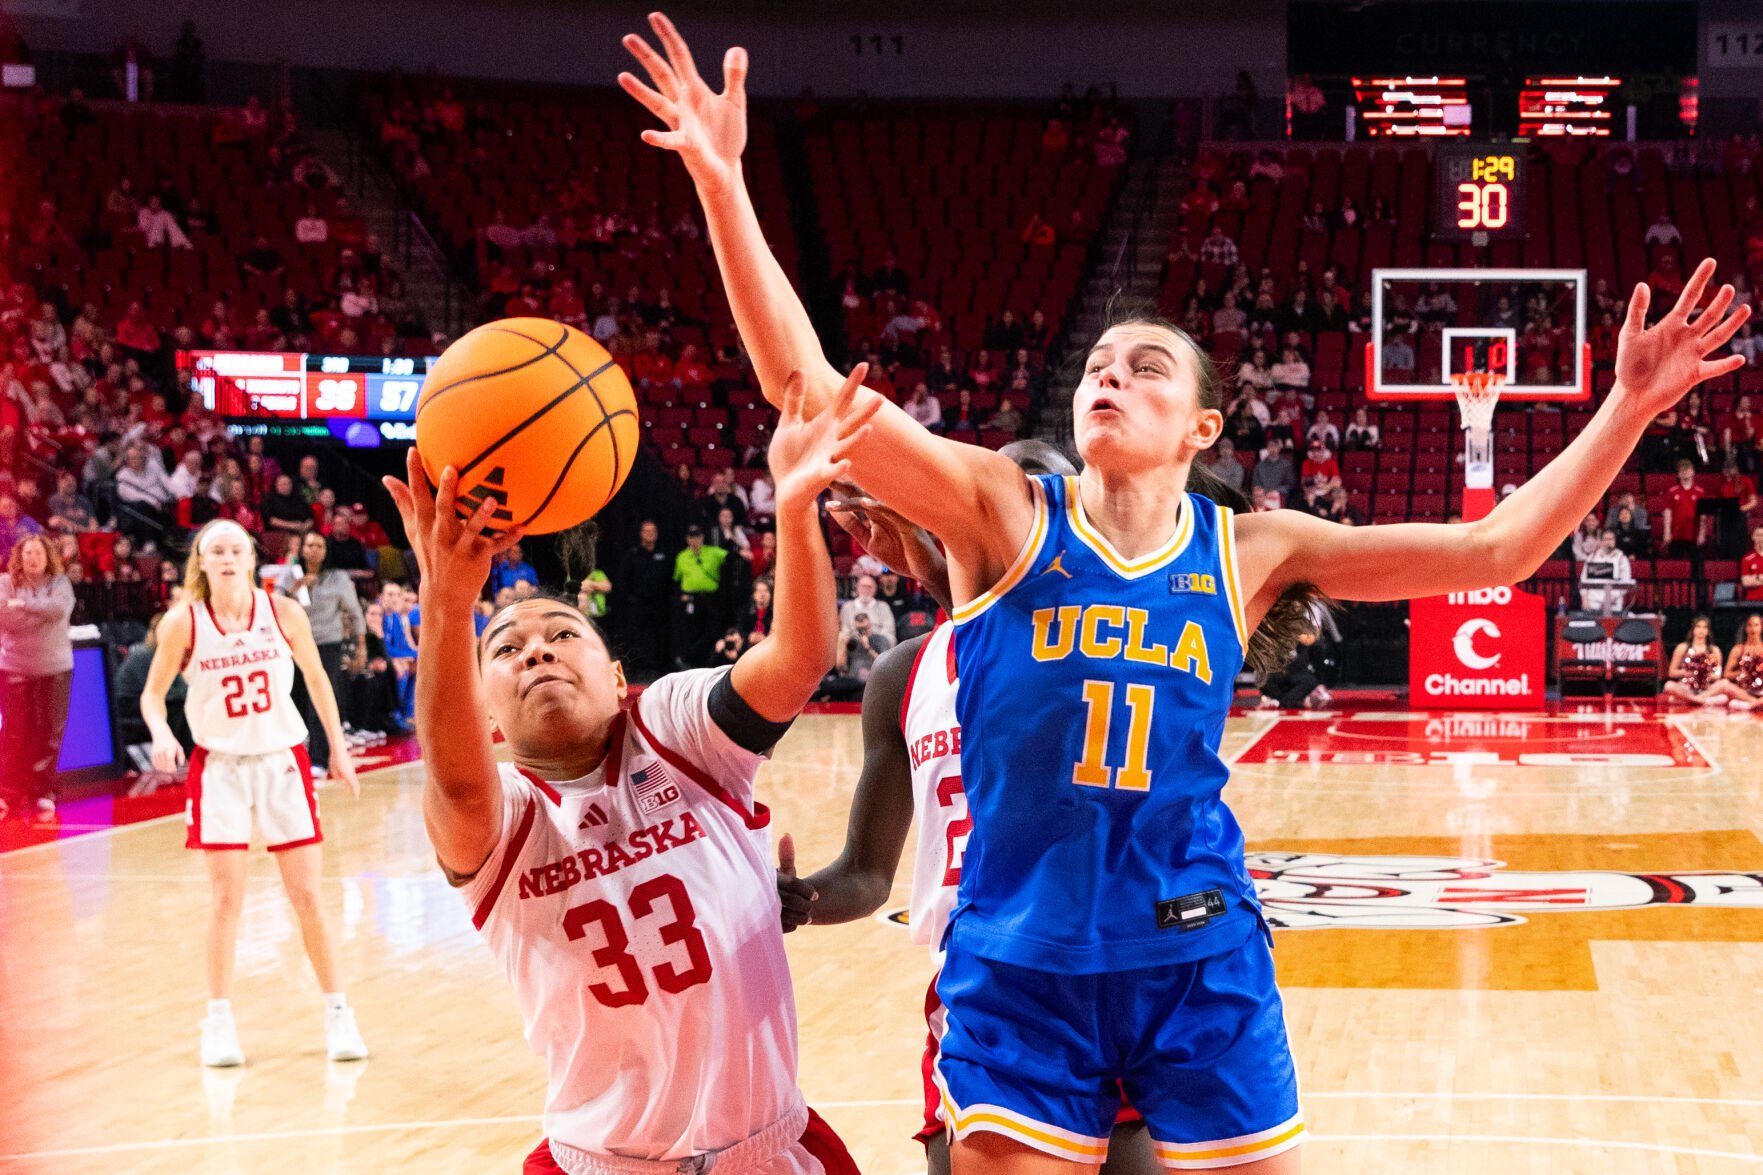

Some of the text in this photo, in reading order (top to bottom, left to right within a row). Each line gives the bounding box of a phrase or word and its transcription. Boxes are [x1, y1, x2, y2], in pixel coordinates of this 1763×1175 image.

[849, 34, 903, 56] 111
[1472, 156, 1515, 183] 1:29
[1457, 183, 1508, 229] 30
[380, 380, 419, 412] 57
[200, 648, 280, 672] NEBRASKA
[1031, 604, 1213, 686] UCLA
[221, 670, 272, 719] 23
[1424, 672, 1528, 695] Channel
[1072, 679, 1156, 792] 11
[518, 811, 708, 900] NEBRASKA
[562, 873, 714, 1009] 33
